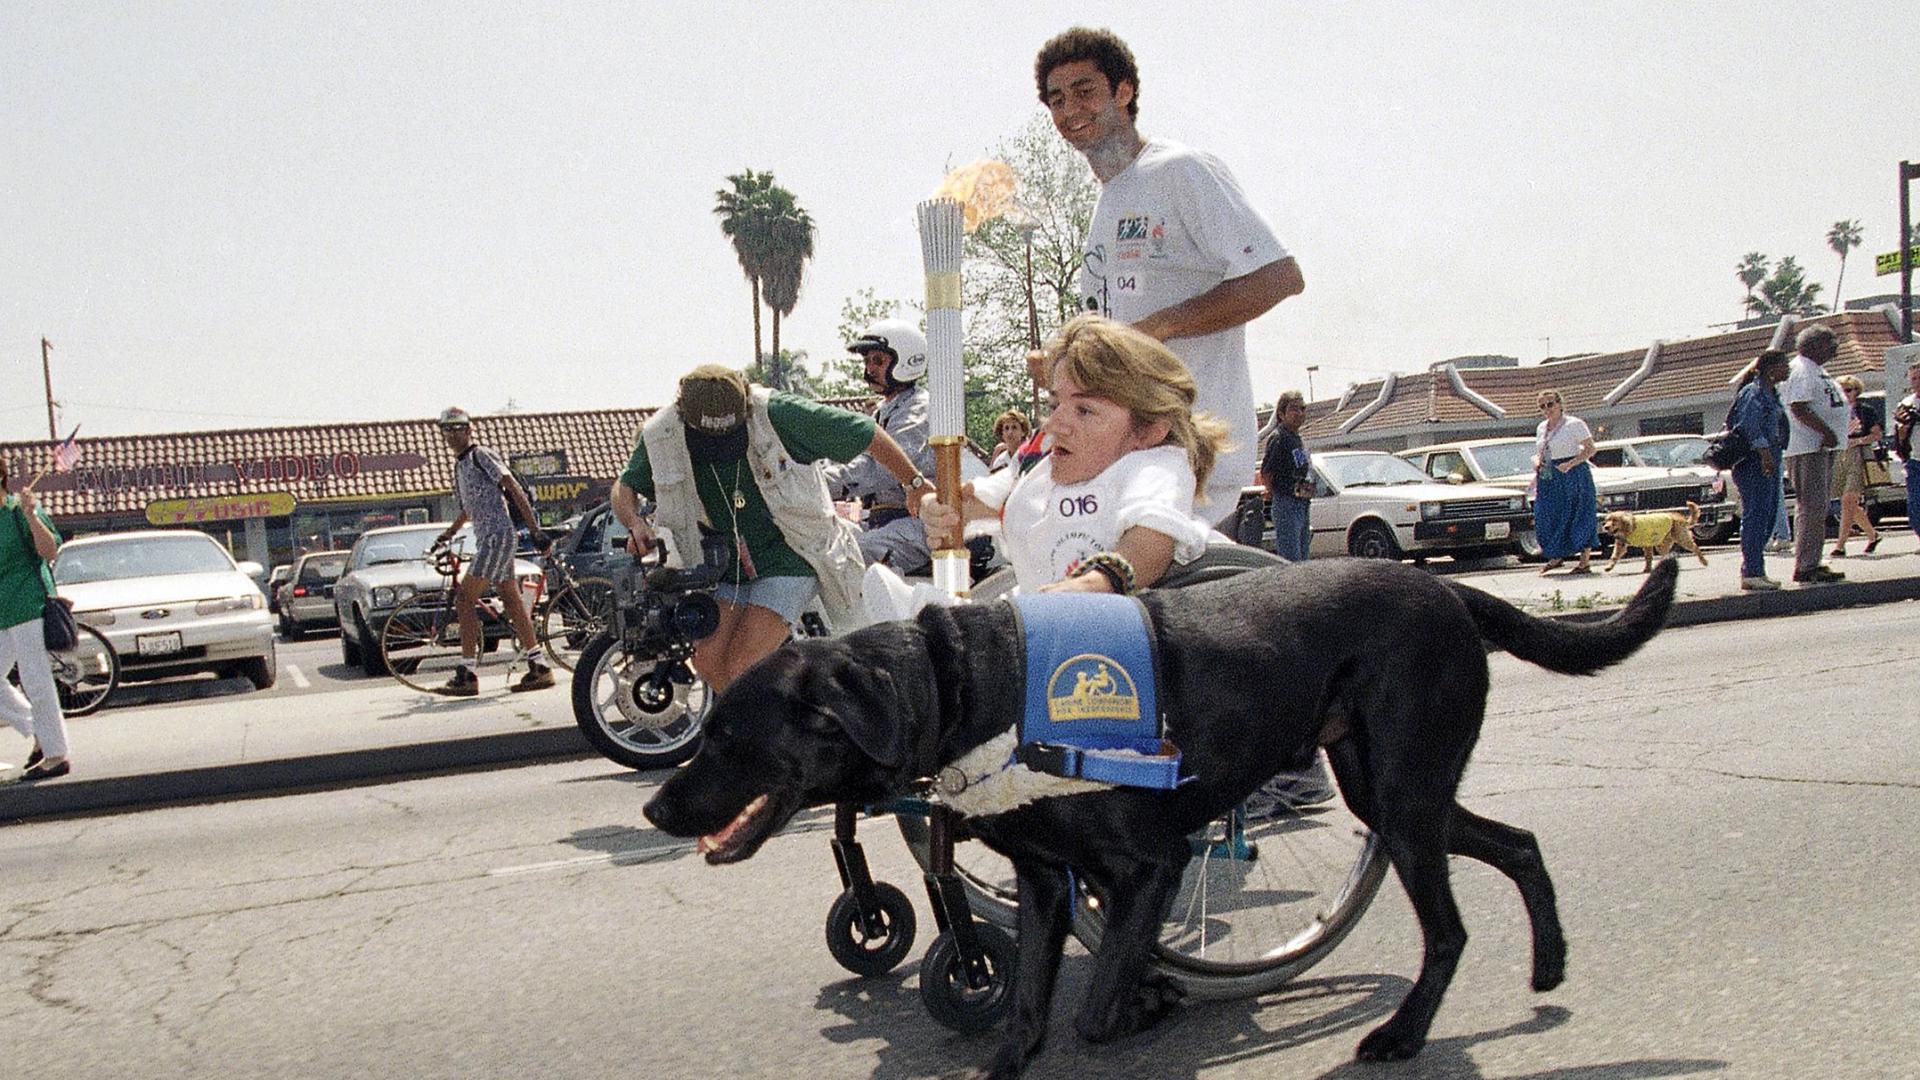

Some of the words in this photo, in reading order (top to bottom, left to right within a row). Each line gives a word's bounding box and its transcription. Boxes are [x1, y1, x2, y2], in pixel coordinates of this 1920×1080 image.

[1117, 275, 1136, 291] 04
[233, 451, 360, 485] VIDEO
[1059, 494, 1098, 517] 016
